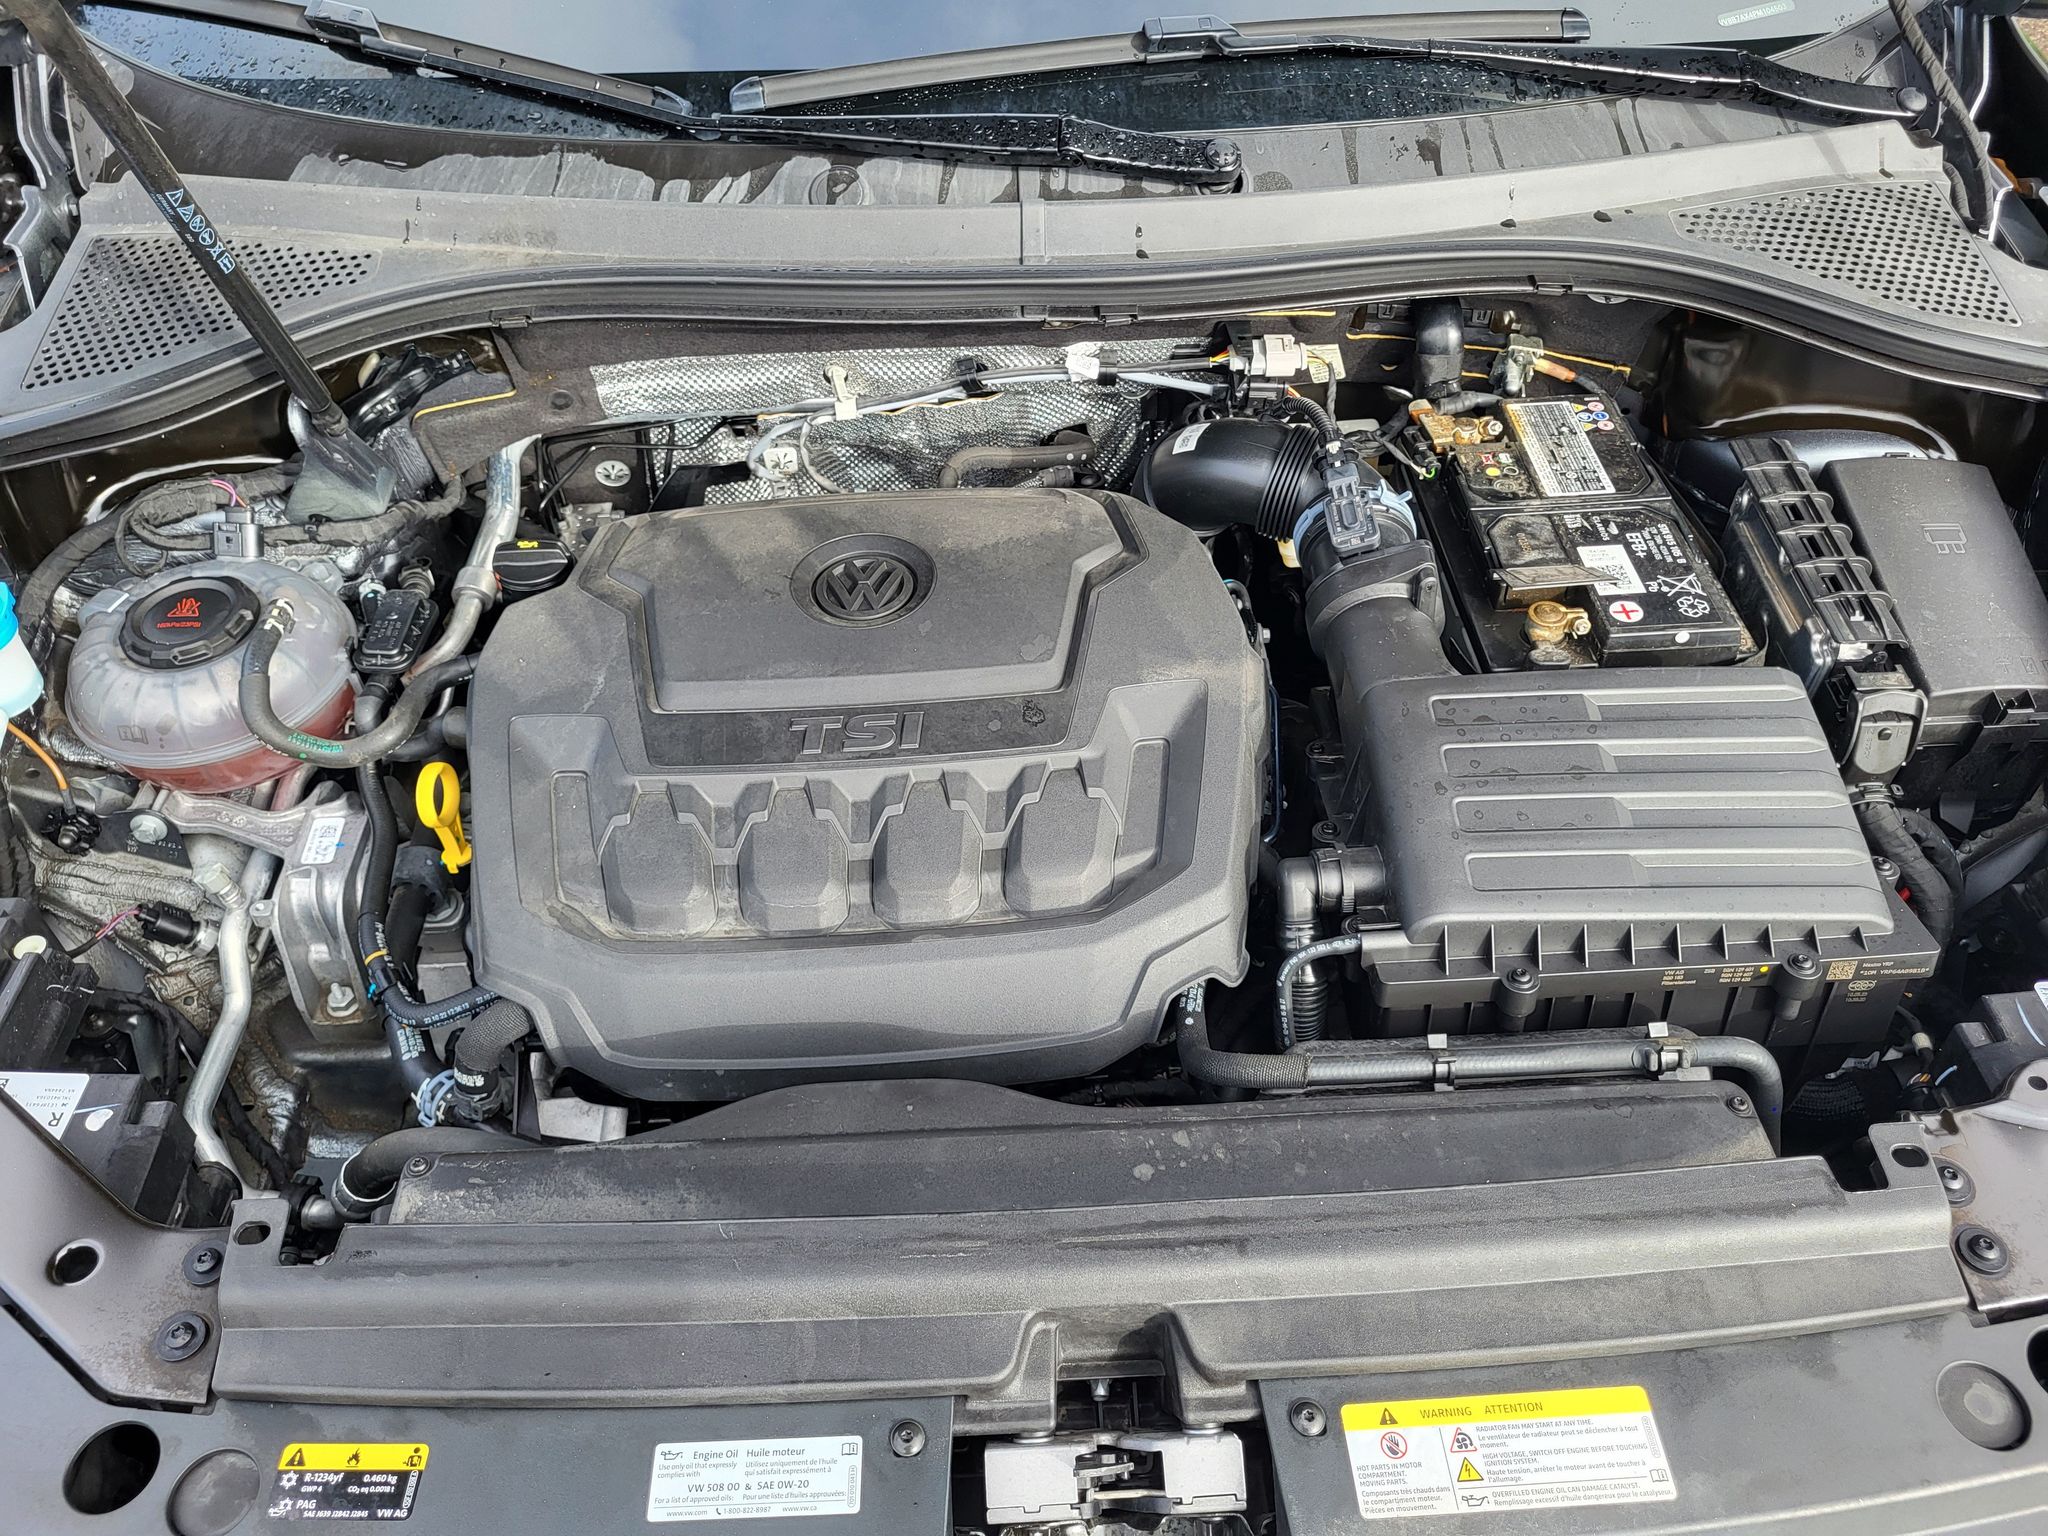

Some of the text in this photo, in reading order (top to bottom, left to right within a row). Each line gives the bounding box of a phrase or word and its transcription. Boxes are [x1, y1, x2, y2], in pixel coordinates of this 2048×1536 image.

[1592, 516, 1610, 541] CLARIOS
[1626, 533, 1648, 558] EFB+
[814, 552, 917, 621] VW
[1646, 581, 1659, 592] Pb
[790, 711, 925, 755] TSI
[48, 1112, 64, 1127] R
[1420, 1402, 1544, 1419] WARNING ATTENTION
[1476, 1424, 1507, 1432] RADIATOR
[1487, 1432, 1521, 1440] ventilateur
[1531, 1430, 1559, 1438] radiateur
[1561, 1429, 1575, 1437] peut
[1585, 1426, 1618, 1434] déclencher
[1480, 1441, 1509, 1449] moment.
[1482, 1452, 1498, 1460] HIGH
[1528, 1449, 1553, 1457] SWITCH
[1566, 1446, 1590, 1454] ENGINE
[1591, 1445, 1615, 1453] BEFORE
[1616, 1443, 1648, 1451] TOUCHING
[693, 1447, 805, 1461] Engine Oil Huile moteur
[659, 1463, 670, 1471] Use
[671, 1463, 685, 1472] only
[694, 1461, 707, 1469] that
[708, 1461, 738, 1470] expressly
[770, 1459, 808, 1468] uniquement
[809, 1458, 818, 1466] de
[1371, 1463, 1390, 1471] PARTS
[1484, 1459, 1512, 1467] IGNITION
[1486, 1468, 1506, 1476] Haute
[1507, 1466, 1533, 1475] tension,
[1616, 1460, 1640, 1468] toucher
[303, 1473, 398, 1484] R-1234yf 0.460 kg
[657, 1471, 685, 1480] complies
[744, 1469, 755, 1478] qui
[756, 1467, 781, 1475] satisfait
[782, 1466, 826, 1475] expressément
[1358, 1470, 1408, 1480] COMPARTMENT.
[688, 1483, 705, 1493] VW
[707, 1483, 725, 1492] 508
[727, 1482, 740, 1491] 00
[757, 1481, 775, 1490] SAE
[777, 1479, 809, 1489] 0W-20
[1360, 1479, 1385, 1487] MOVING
[1492, 1482, 1641, 1498] OVERFILLED ENGINE OIL CAN DAMAGE CATALYST.
[689, 1495, 719, 1504] approved
[785, 1491, 808, 1499] d'huiles
[809, 1490, 846, 1499] approuvées:
[1362, 1488, 1400, 1497] Composants
[1413, 1486, 1435, 1494] chauds
[1494, 1498, 1534, 1506] Remplissage
[1560, 1494, 1581, 1502] d'huile
[1583, 1493, 1616, 1502] dangereux
[1639, 1489, 1674, 1497] catalyseur.
[296, 1500, 316, 1510] PAG
[1371, 1496, 1416, 1506] compartiment
[377, 1509, 393, 1517] VW
[393, 1509, 408, 1517] AG
[724, 1506, 771, 1515] 1-800-822-8987
[1365, 1505, 1385, 1514] Pièces
[1396, 1504, 1437, 1512] mouvement.
